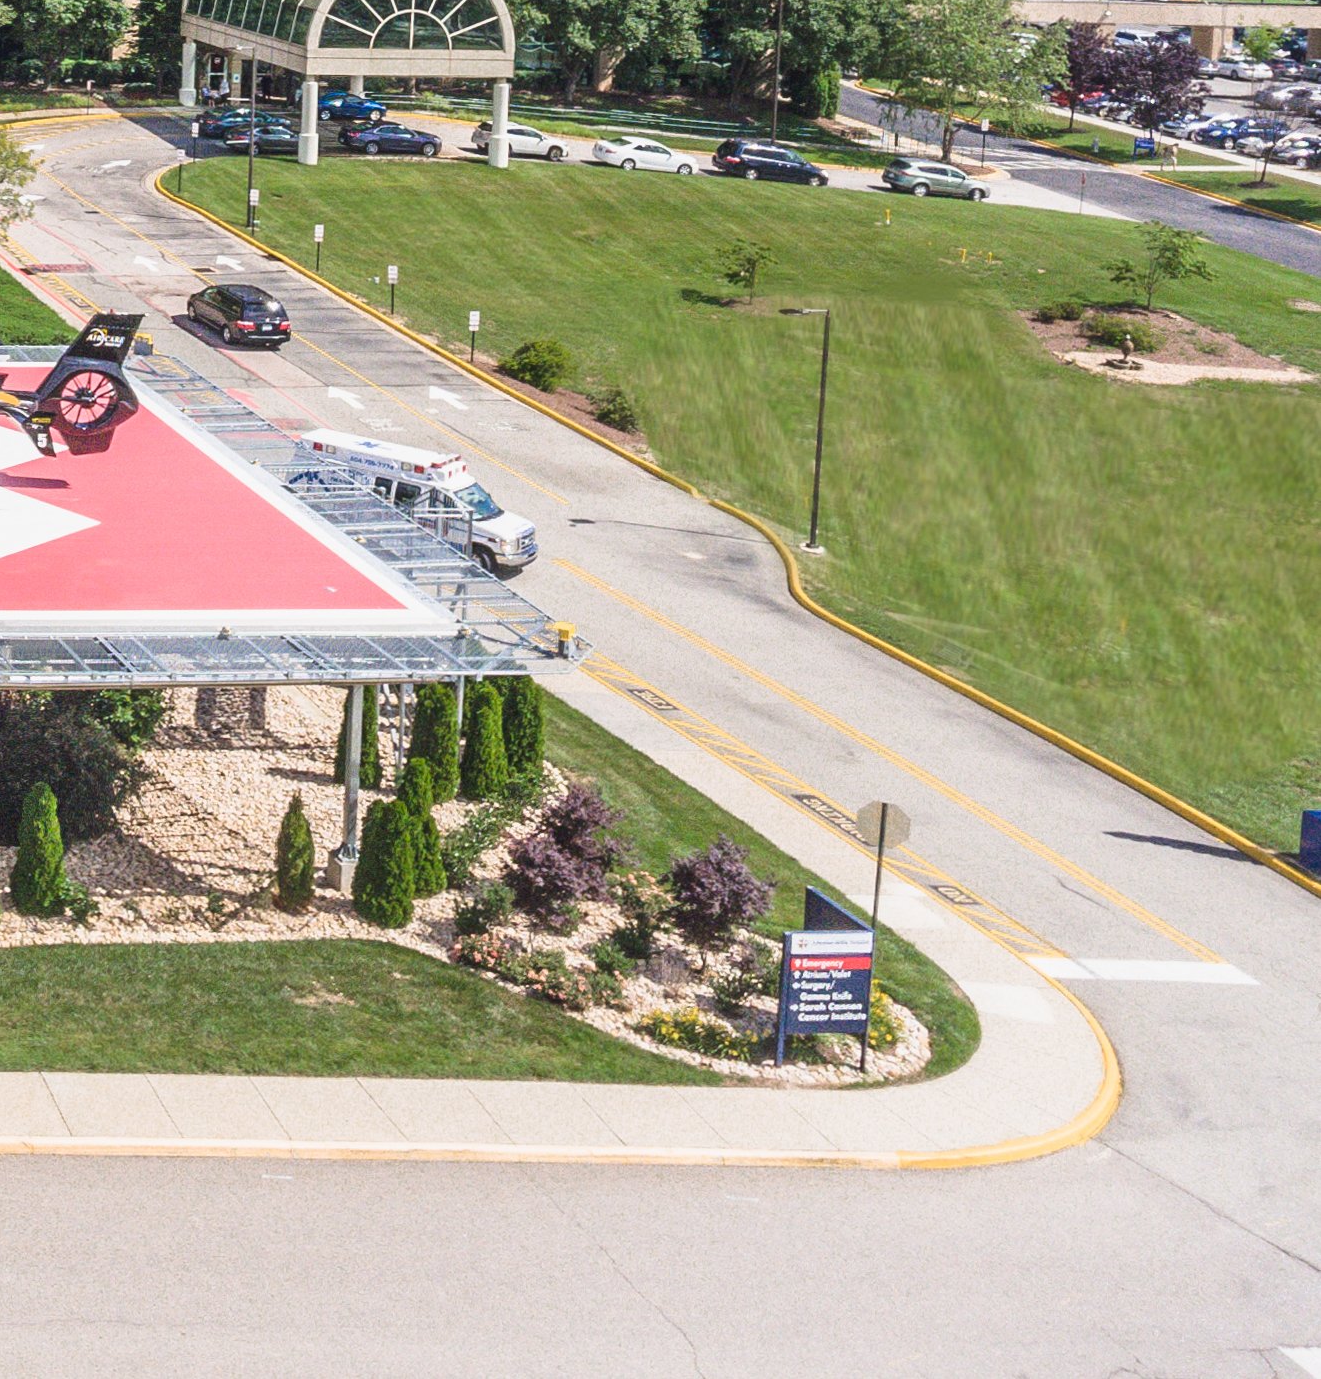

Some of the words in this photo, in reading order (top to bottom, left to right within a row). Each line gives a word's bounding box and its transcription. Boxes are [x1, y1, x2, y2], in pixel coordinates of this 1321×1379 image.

[37, 433, 48, 448] 5
[802, 958, 844, 969] Emergency
[800, 980, 835, 991] Surgery/
[832, 991, 852, 1000] Knife
[799, 1002, 826, 1011] Sarah
[798, 1013, 829, 1021] Cancer
[831, 1012, 866, 1020] Institute
